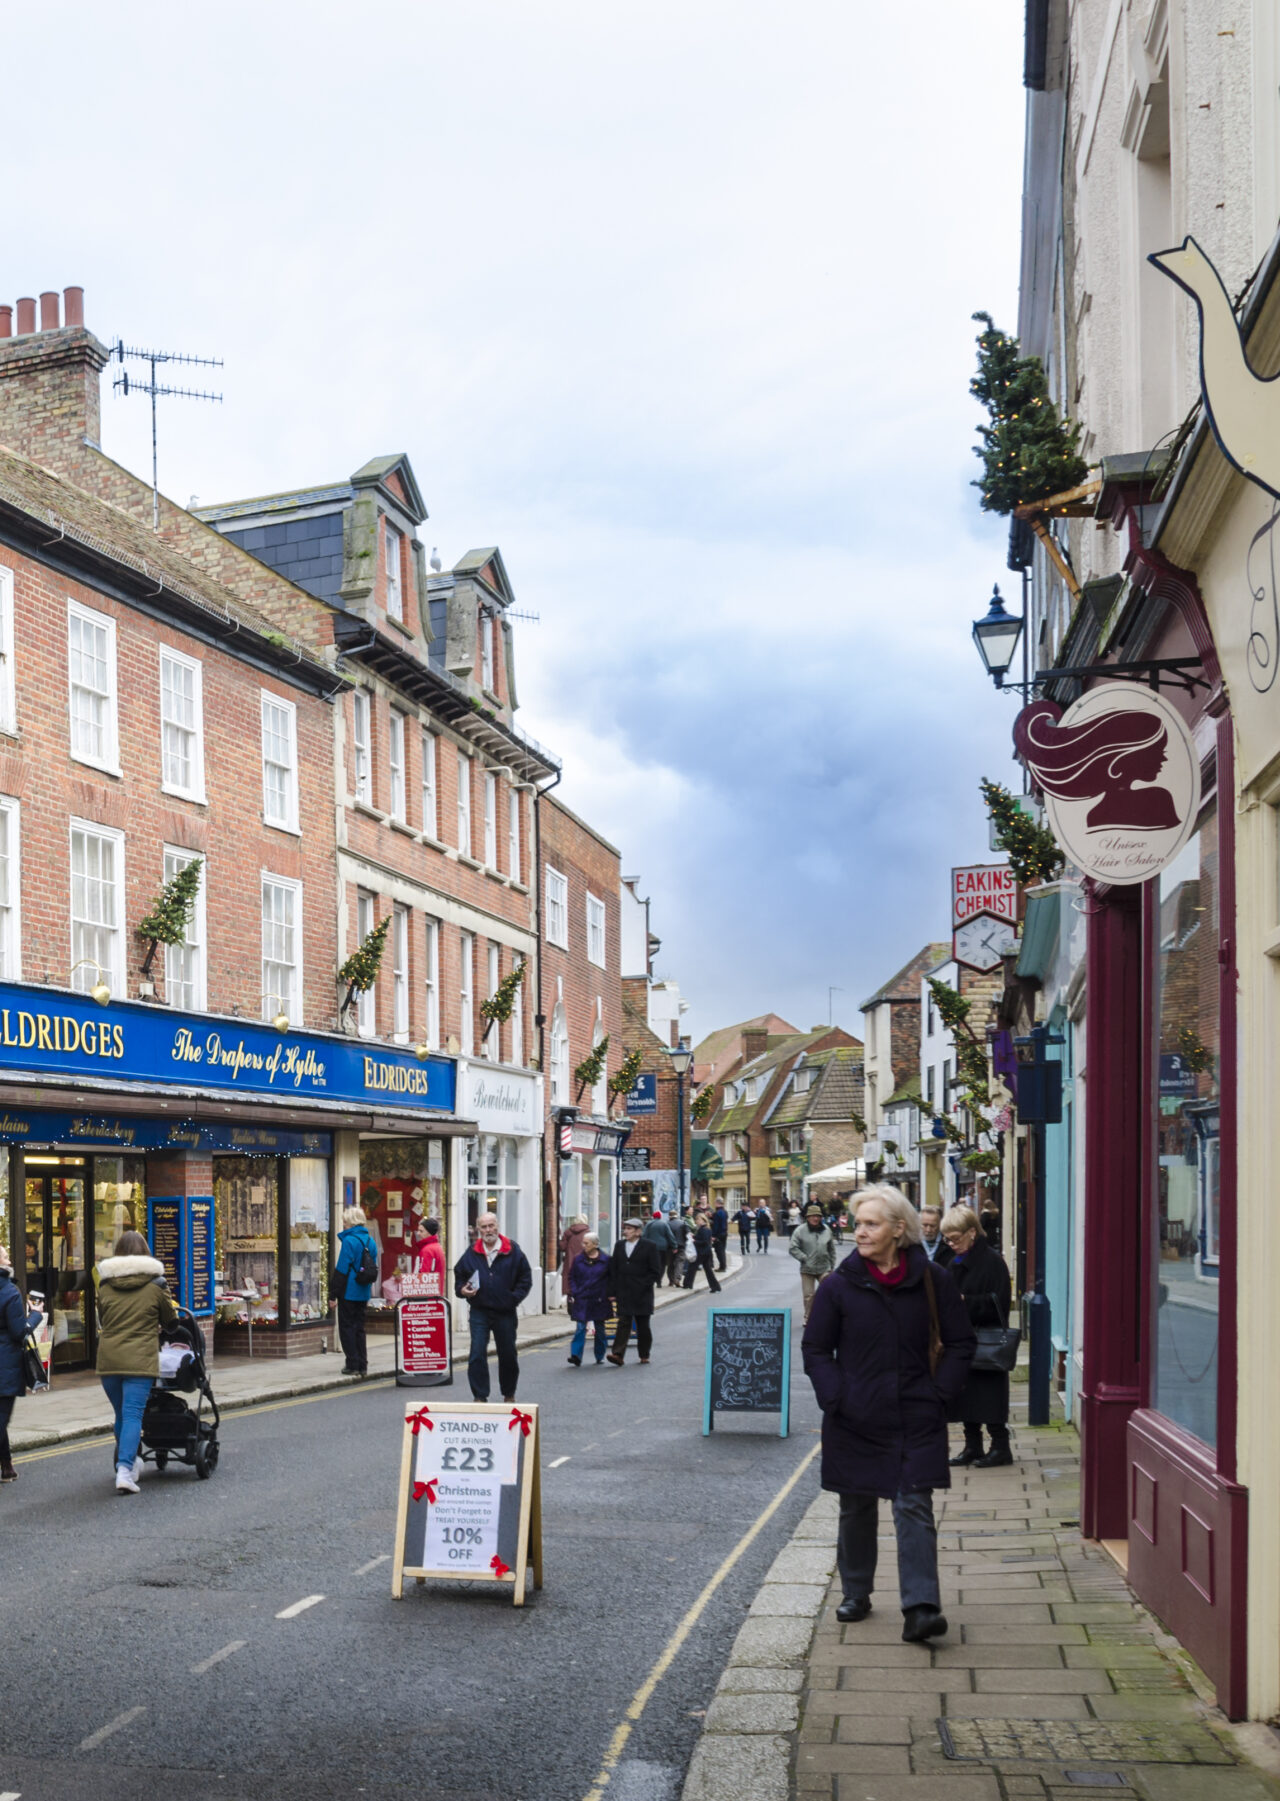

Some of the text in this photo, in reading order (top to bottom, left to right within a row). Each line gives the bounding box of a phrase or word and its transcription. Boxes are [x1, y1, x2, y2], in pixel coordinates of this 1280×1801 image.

[1098, 836, 1147, 851] Unisex
[1087, 851, 1165, 868] Hair Salon
[956, 870, 1013, 893] EAKINS
[955, 893, 1015, 918] CHEMIST
[171, 1027, 327, 1087] The Drapers of Hythe
[364, 1056, 428, 1095] ELDRIDGES
[473, 1078, 521, 1113] Bewitched
[402, 1273, 439, 1285] 20% OFF
[439, 1421, 499, 1434] STAND-BY
[440, 1446, 495, 1472] £23
[438, 1485, 492, 1497] Christmas
[435, 1506, 456, 1514] Don't
[457, 1507, 482, 1516] Forget
[441, 1527, 483, 1545] 10%
[448, 1548, 473, 1560] OFF
